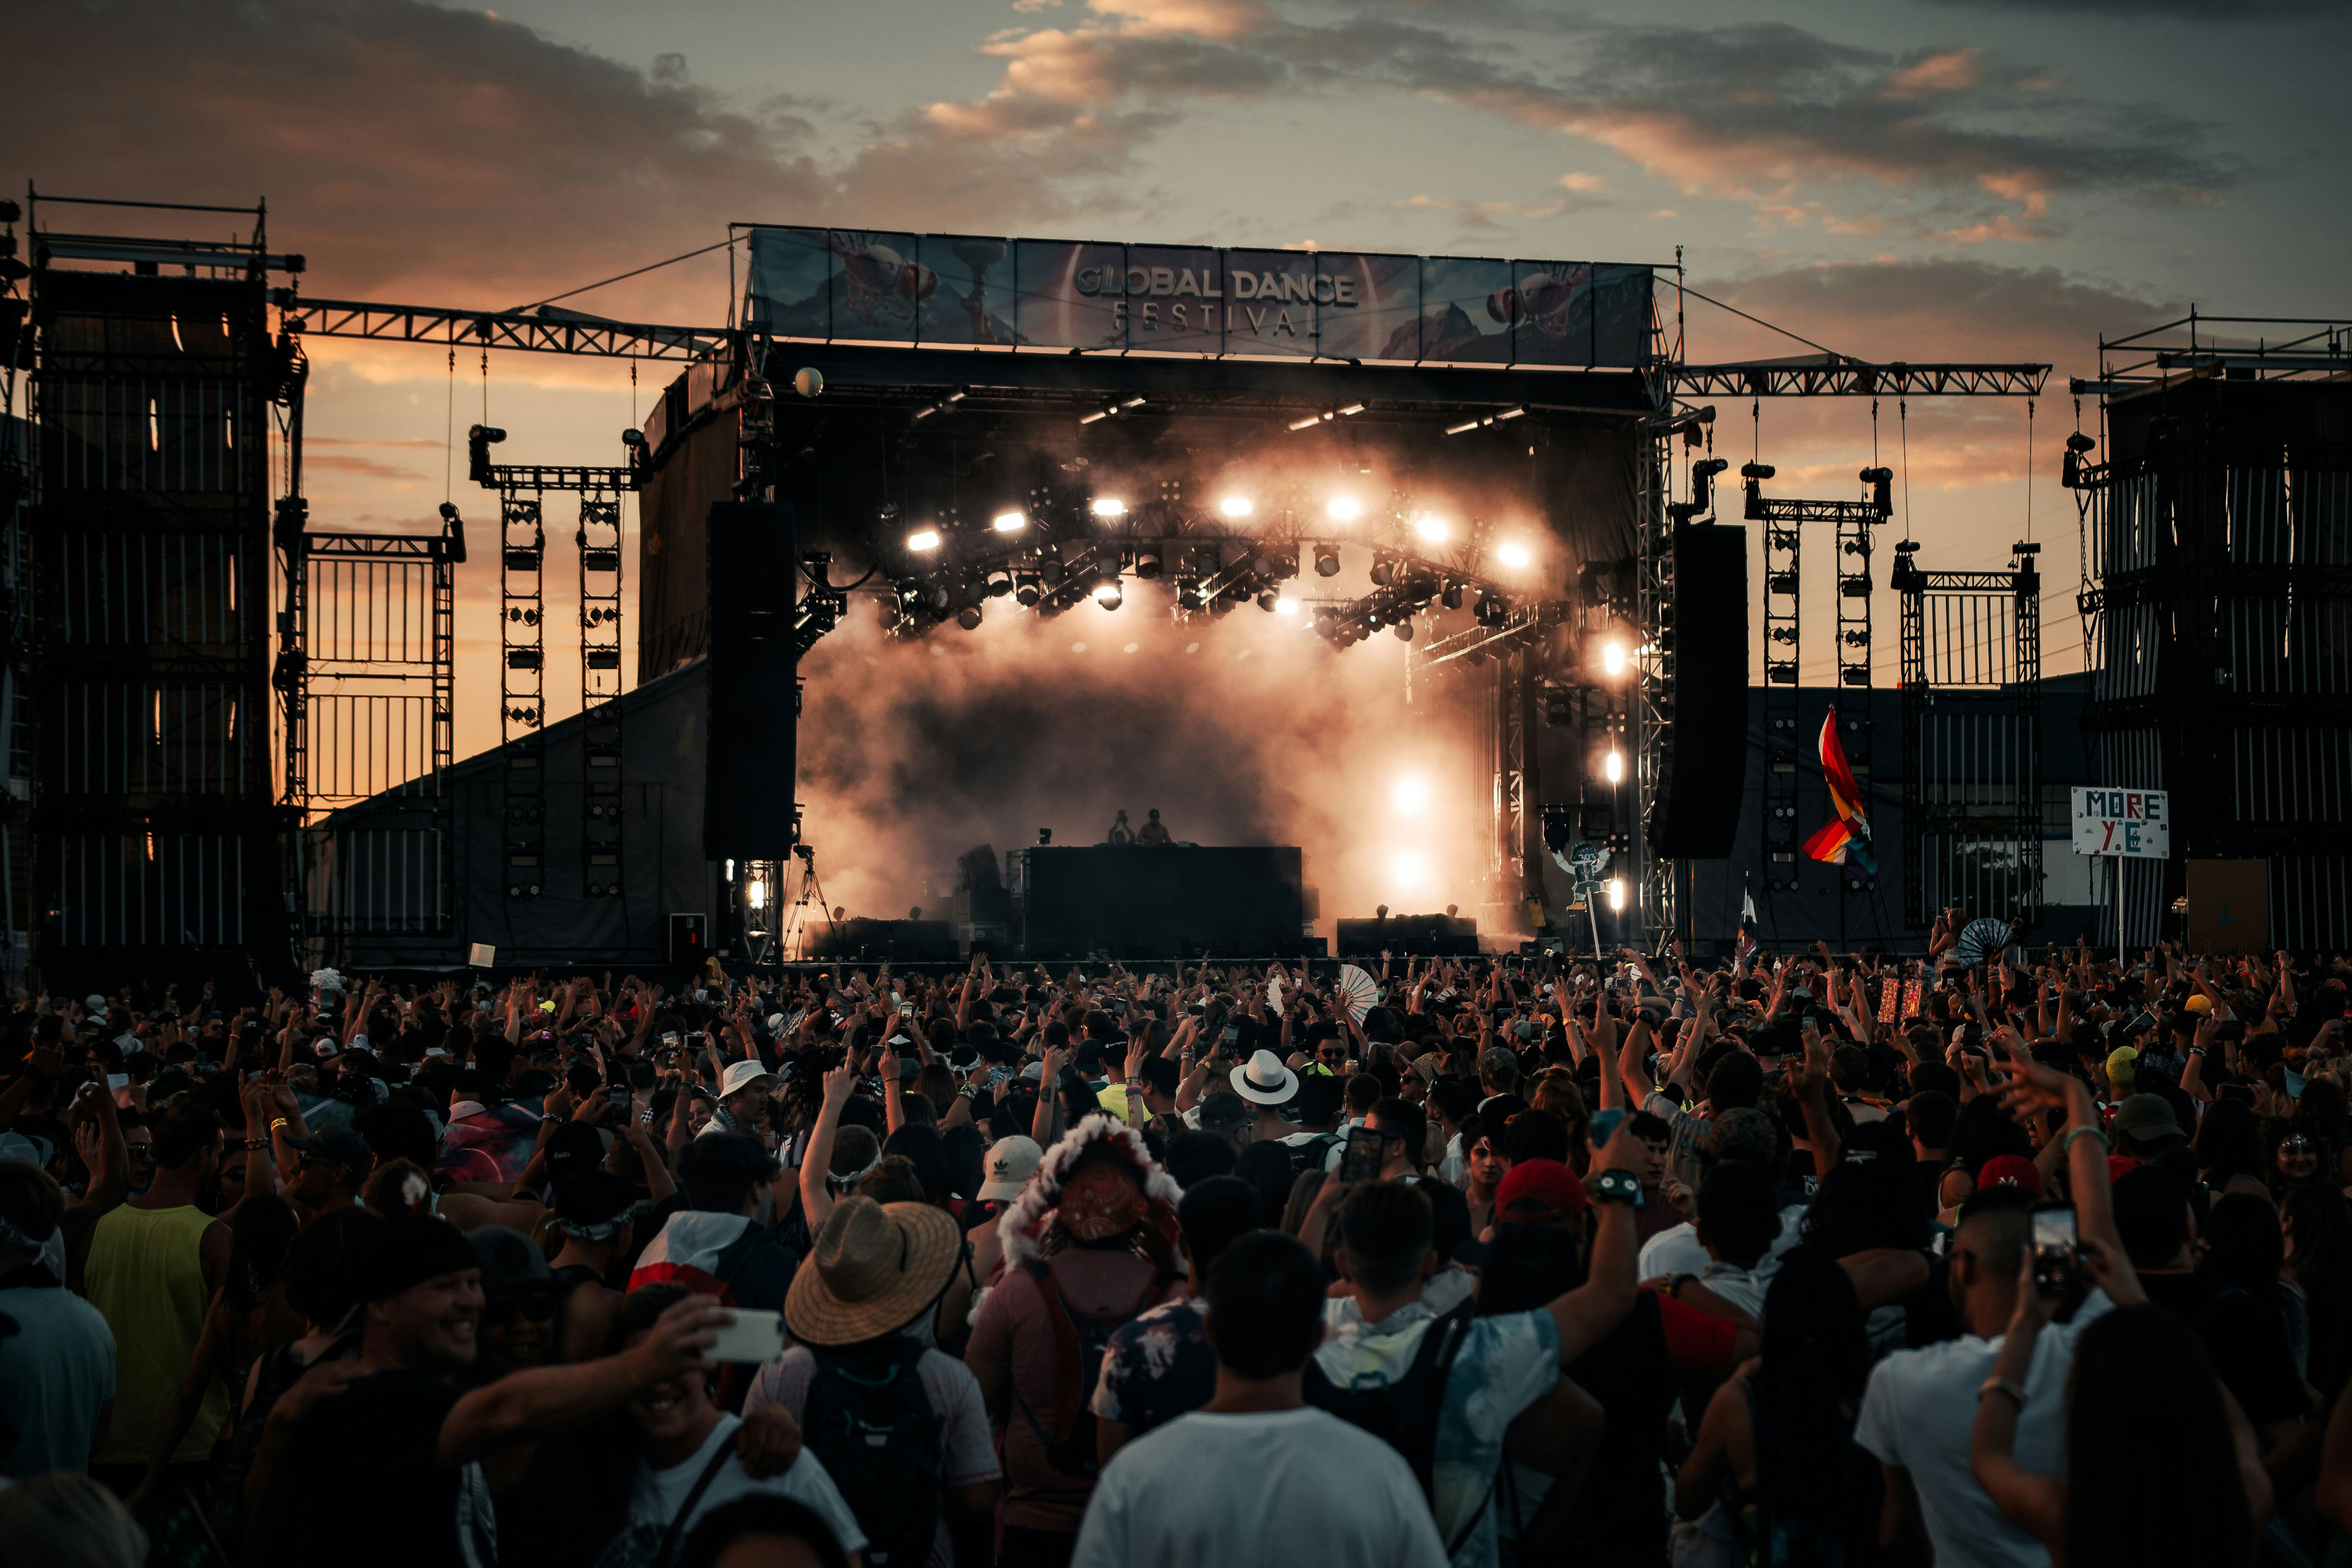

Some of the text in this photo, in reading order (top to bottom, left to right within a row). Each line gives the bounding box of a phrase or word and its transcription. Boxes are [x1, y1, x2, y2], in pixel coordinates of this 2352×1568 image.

[1074, 266, 1359, 308] GLOBAL DANCE
[1113, 301, 1323, 337] FESTIVAL
[2086, 791, 2160, 820] MORE
[2101, 820, 2141, 852] YE
